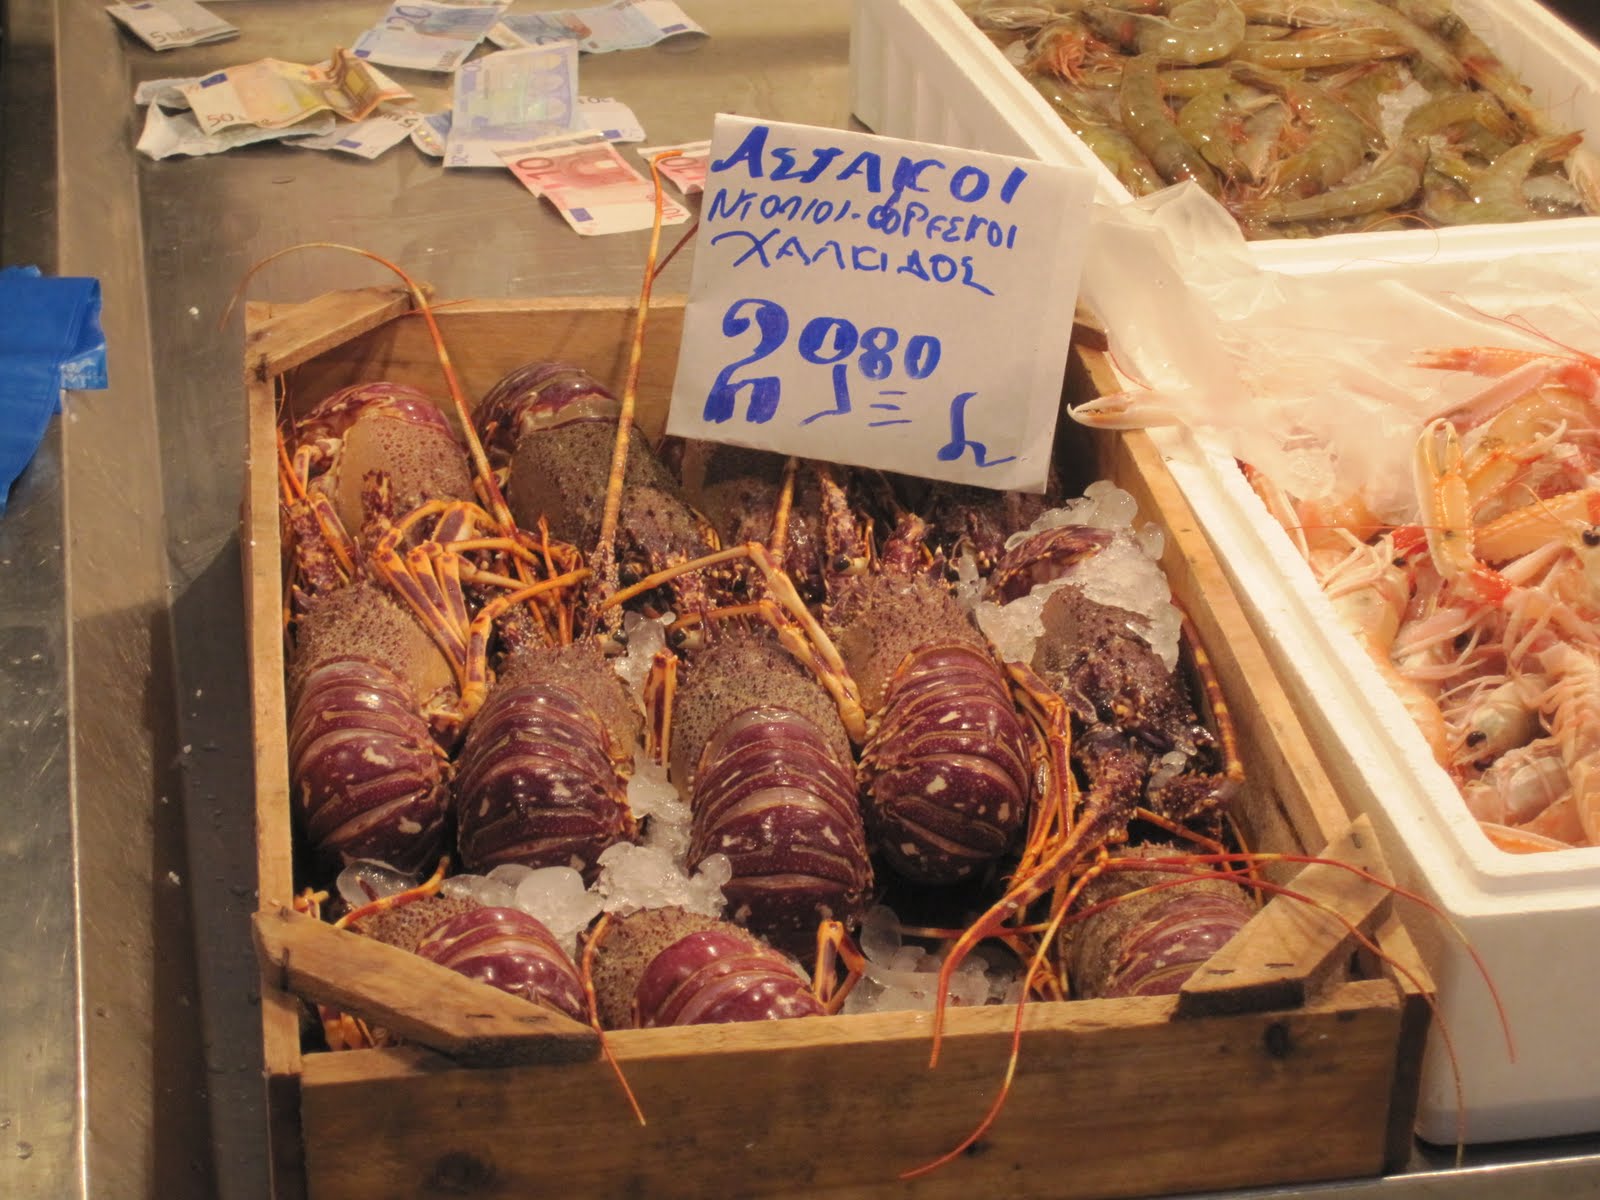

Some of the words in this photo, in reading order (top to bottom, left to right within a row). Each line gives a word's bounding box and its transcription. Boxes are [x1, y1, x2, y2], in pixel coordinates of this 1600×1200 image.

[207, 113, 234, 127] 50
[516, 156, 562, 181] 10
[711, 125, 1028, 205] ΑΣΤΑΚΟΙ
